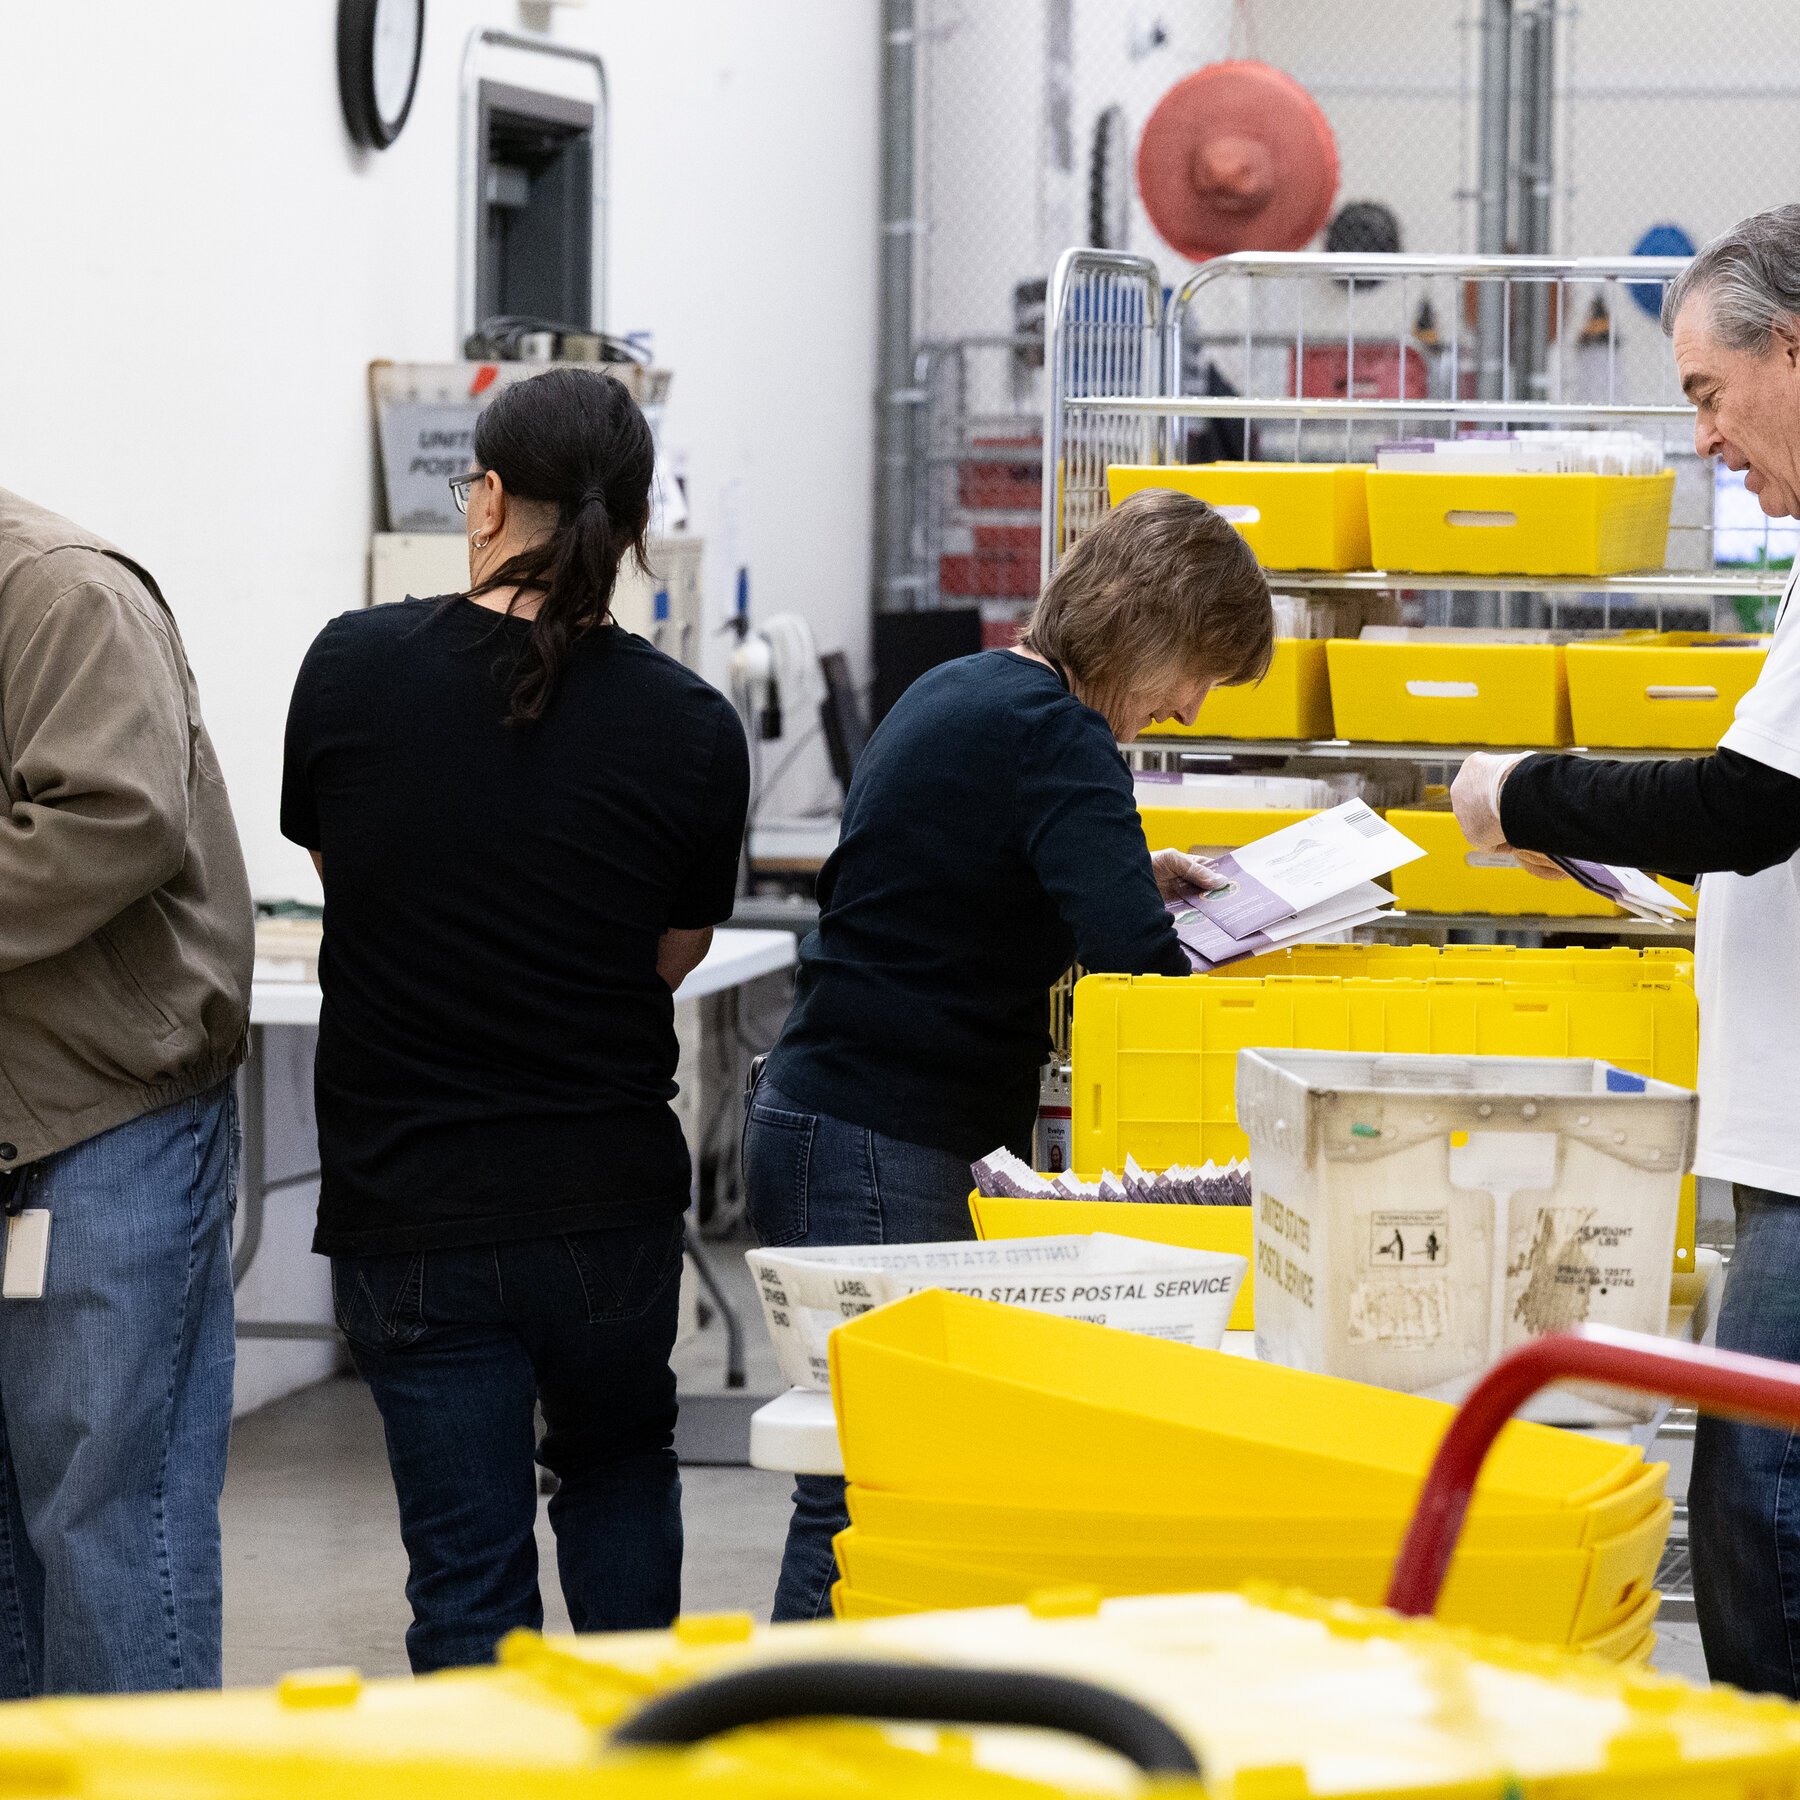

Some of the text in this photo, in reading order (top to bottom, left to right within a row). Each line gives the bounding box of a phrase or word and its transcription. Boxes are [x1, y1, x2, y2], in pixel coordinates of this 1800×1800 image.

[1048, 1127, 1065, 1135] Evelyn
[1261, 1190, 1310, 1255] UNITED STATES
[834, 1279, 872, 1297] LABEL
[1258, 1239, 1313, 1309] POSTAL SERVICE
[988, 1287, 1065, 1304] STATES
[1072, 1282, 1147, 1302] POSTAL
[1153, 1276, 1232, 1299] SERVICE
